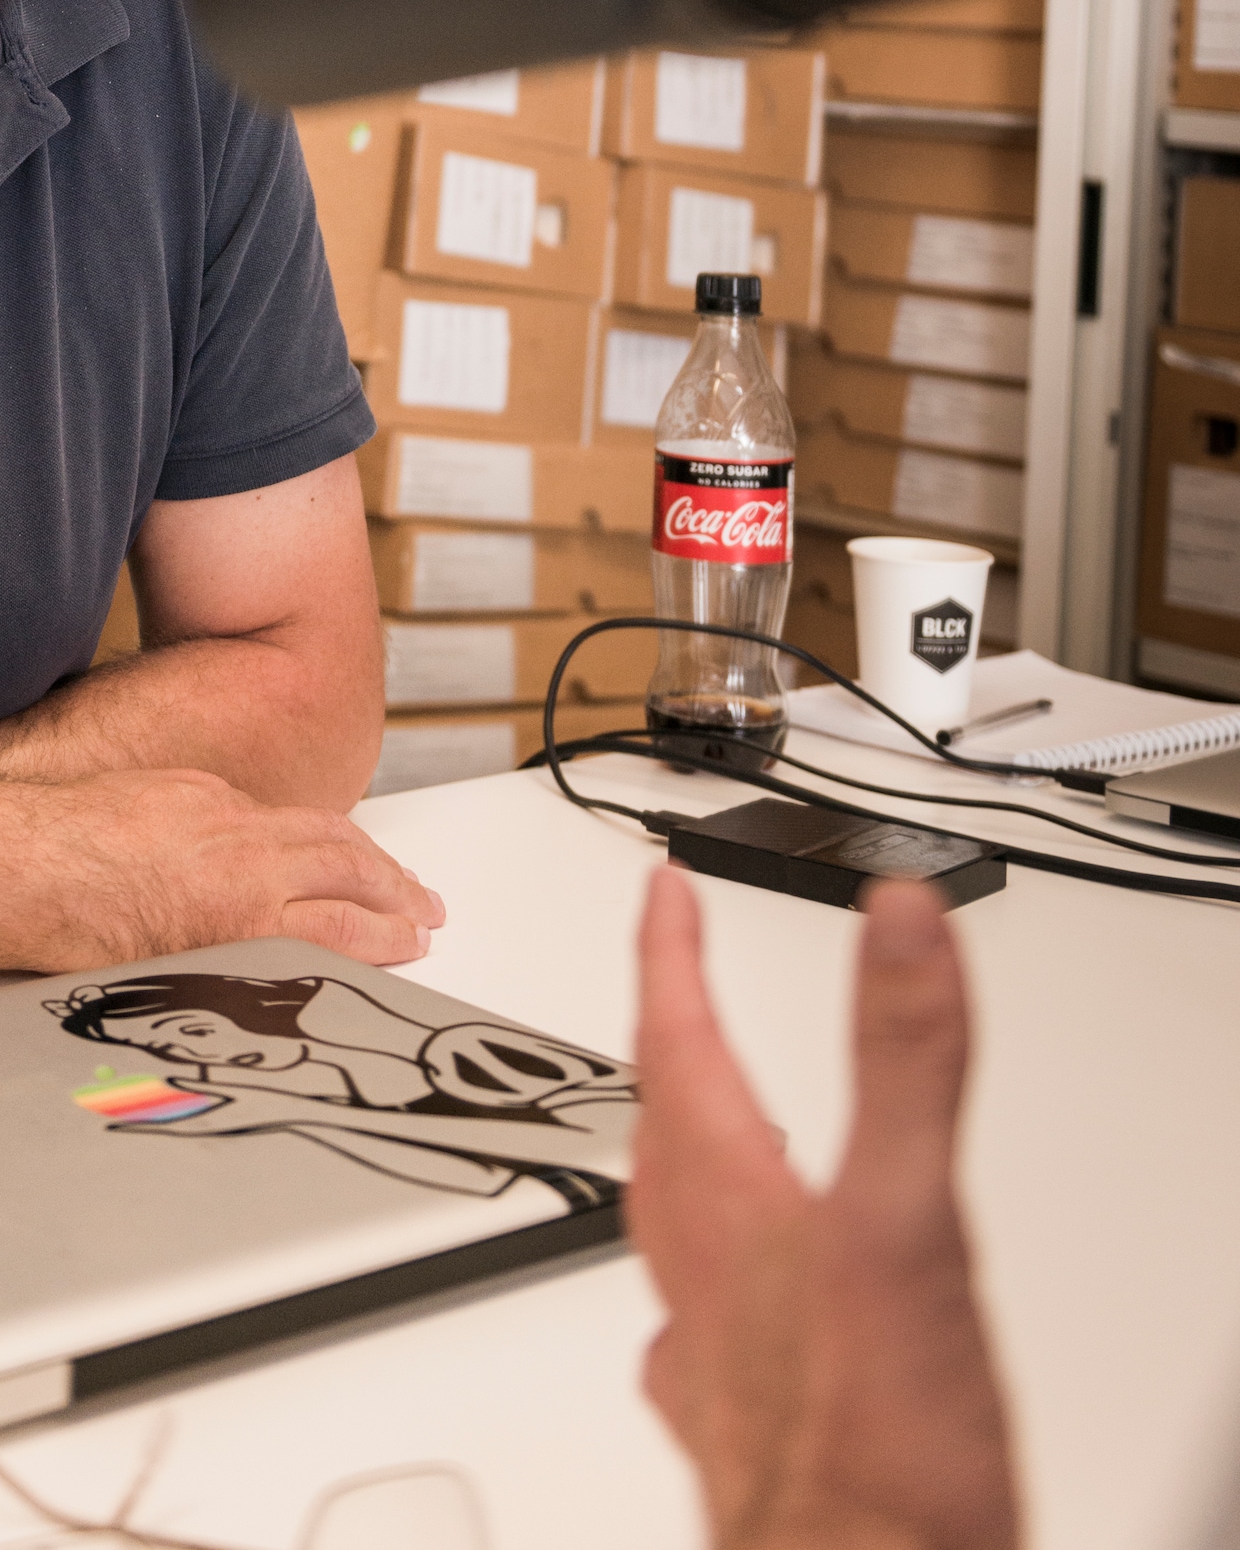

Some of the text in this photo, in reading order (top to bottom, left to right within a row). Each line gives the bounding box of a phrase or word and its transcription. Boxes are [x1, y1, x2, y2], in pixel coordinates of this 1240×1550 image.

[689, 461, 769, 477] ZERO SUGAR
[697, 477, 760, 488] NO CALORIES
[664, 495, 786, 547] Coca-Cola
[921, 616, 967, 638] BLCK
